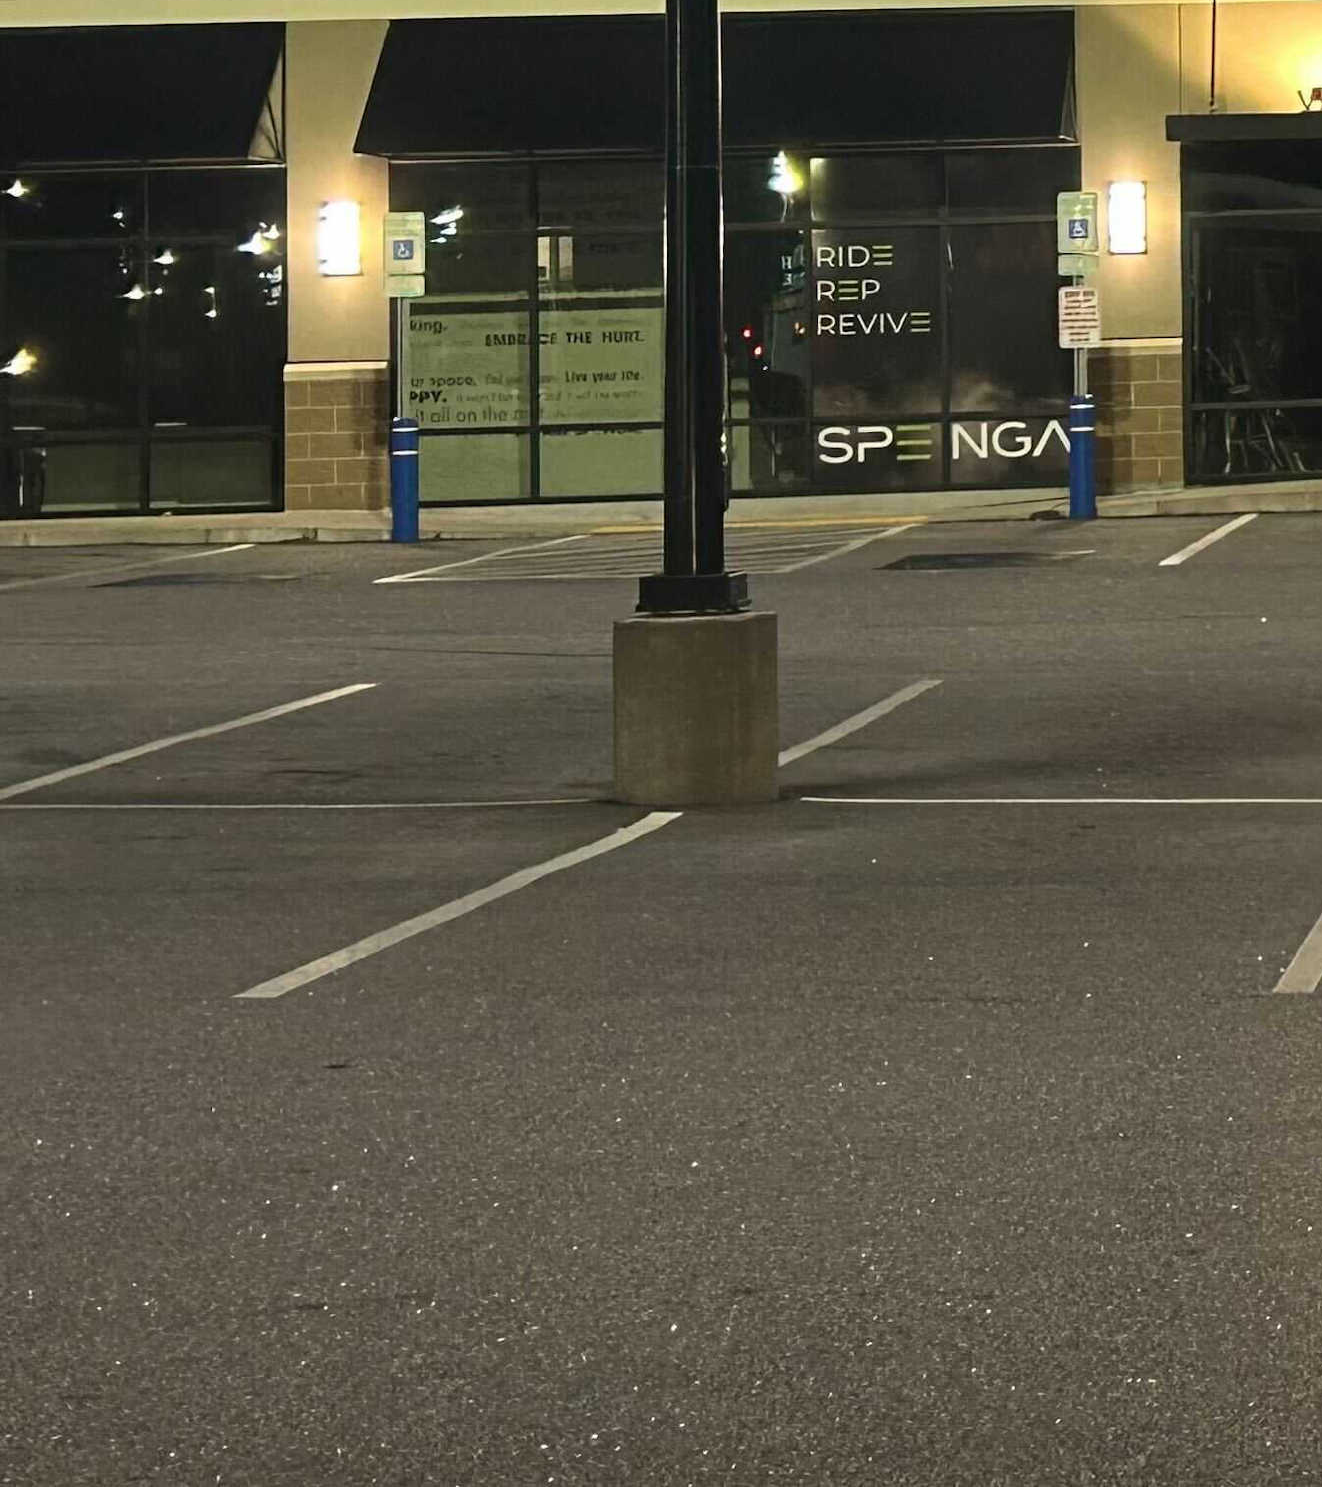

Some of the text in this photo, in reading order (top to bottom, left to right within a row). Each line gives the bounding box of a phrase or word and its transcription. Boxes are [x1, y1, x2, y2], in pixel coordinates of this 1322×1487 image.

[817, 245, 893, 268] RIDE
[817, 280, 880, 301] REP
[817, 313, 931, 335] REVIVE
[566, 331, 592, 344] THE
[817, 420, 1072, 464] SPENGA
